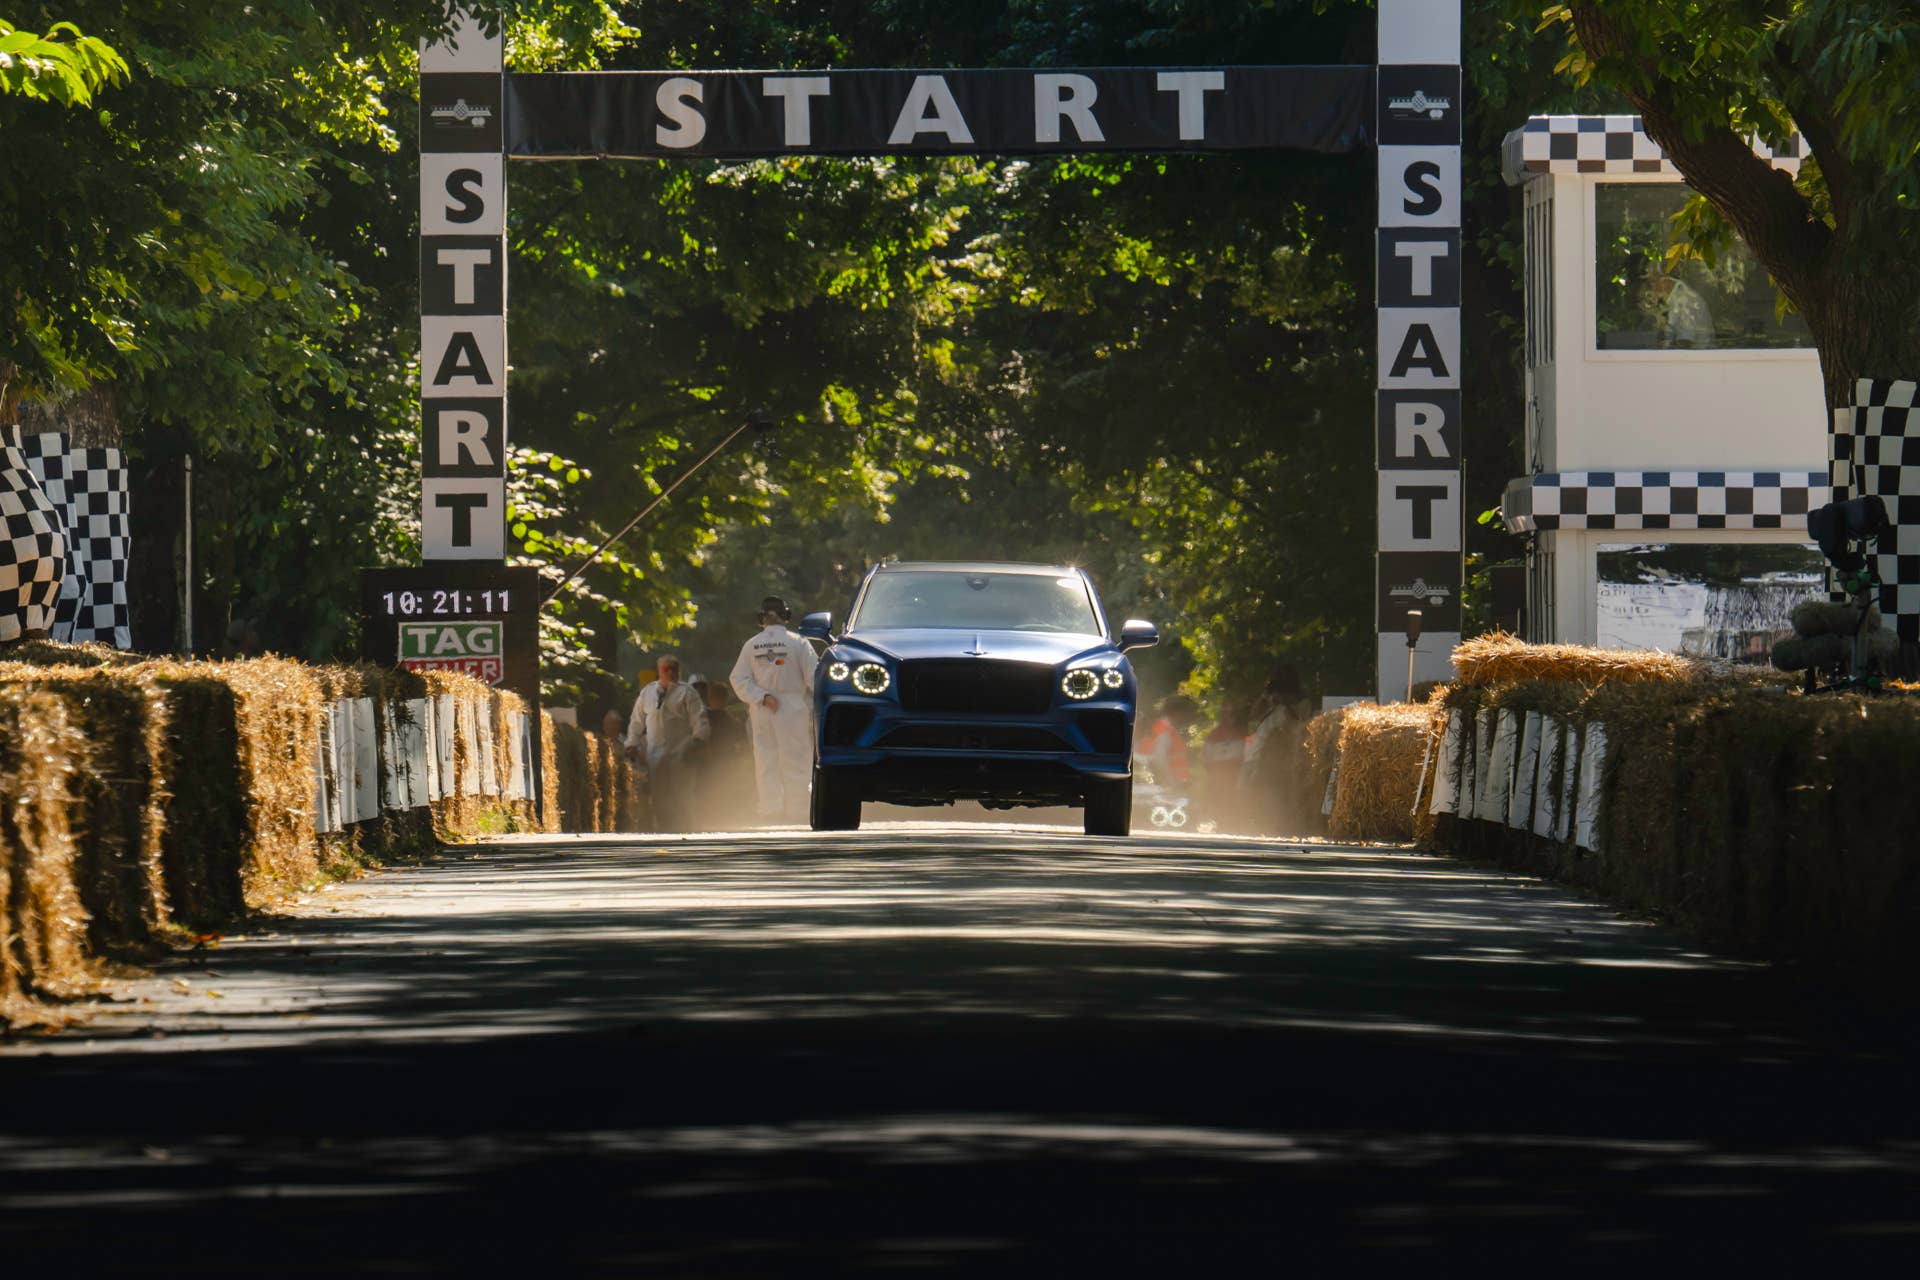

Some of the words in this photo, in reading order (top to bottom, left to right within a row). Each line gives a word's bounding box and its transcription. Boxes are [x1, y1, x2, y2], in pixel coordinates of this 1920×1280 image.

[655, 70, 1225, 150] START
[432, 167, 494, 547] START
[1388, 160, 1451, 540] START
[407, 626, 494, 655] TAG
